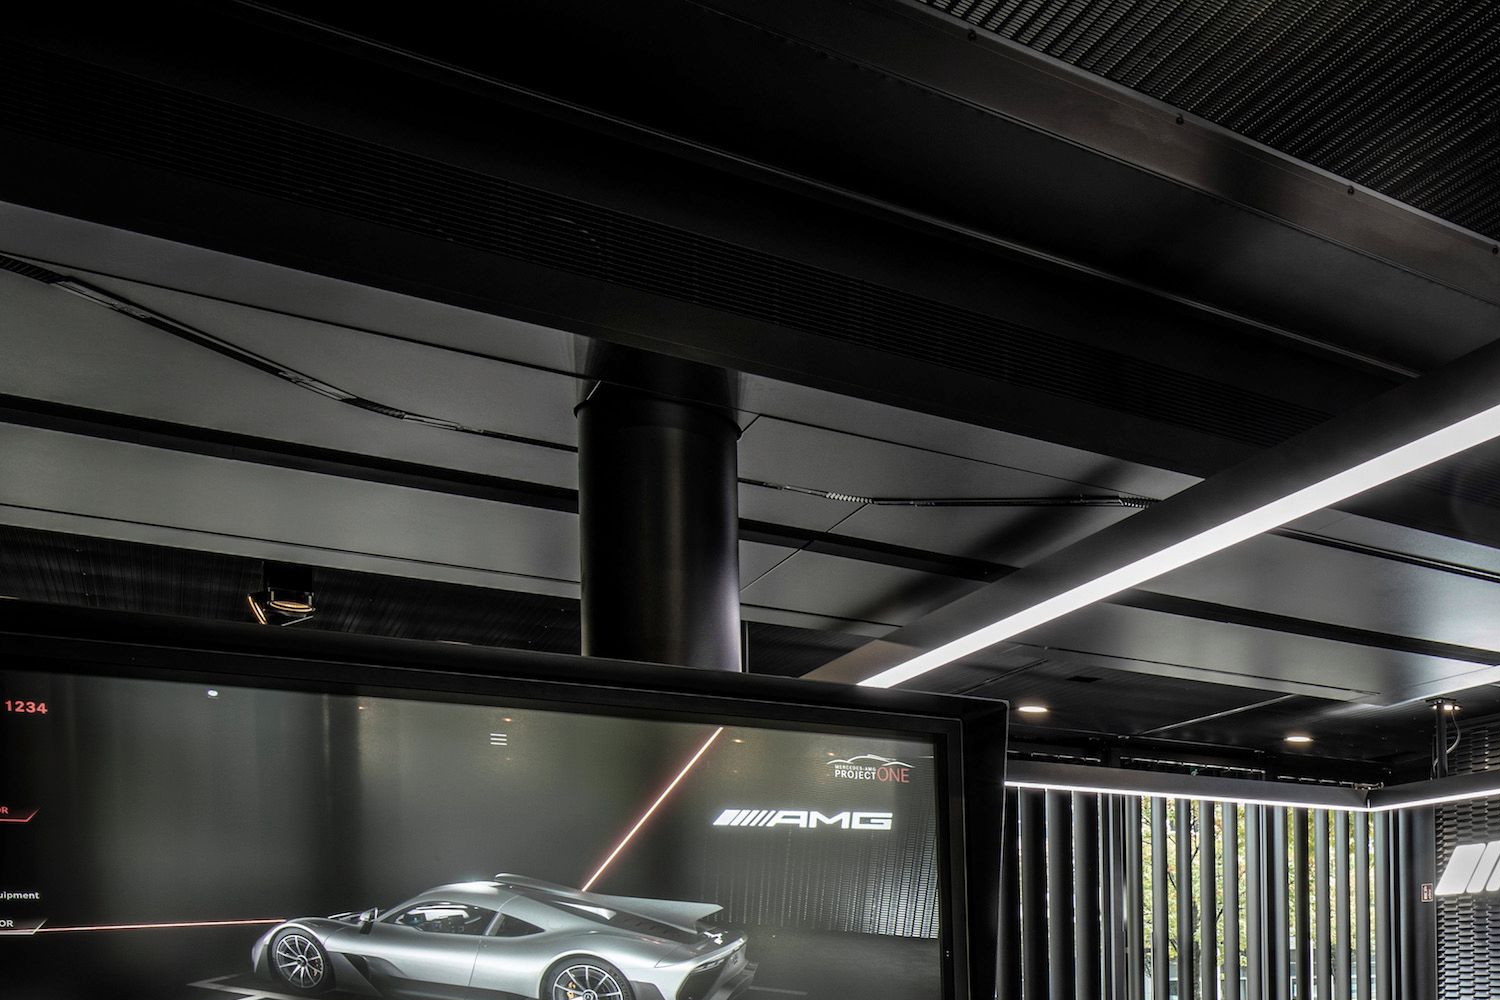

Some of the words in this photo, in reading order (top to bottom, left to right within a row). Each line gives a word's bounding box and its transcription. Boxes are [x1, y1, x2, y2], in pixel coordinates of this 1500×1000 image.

[5, 700, 48, 714] 1234
[834, 769, 876, 780] PROJECT
[876, 767, 909, 783] ONE
